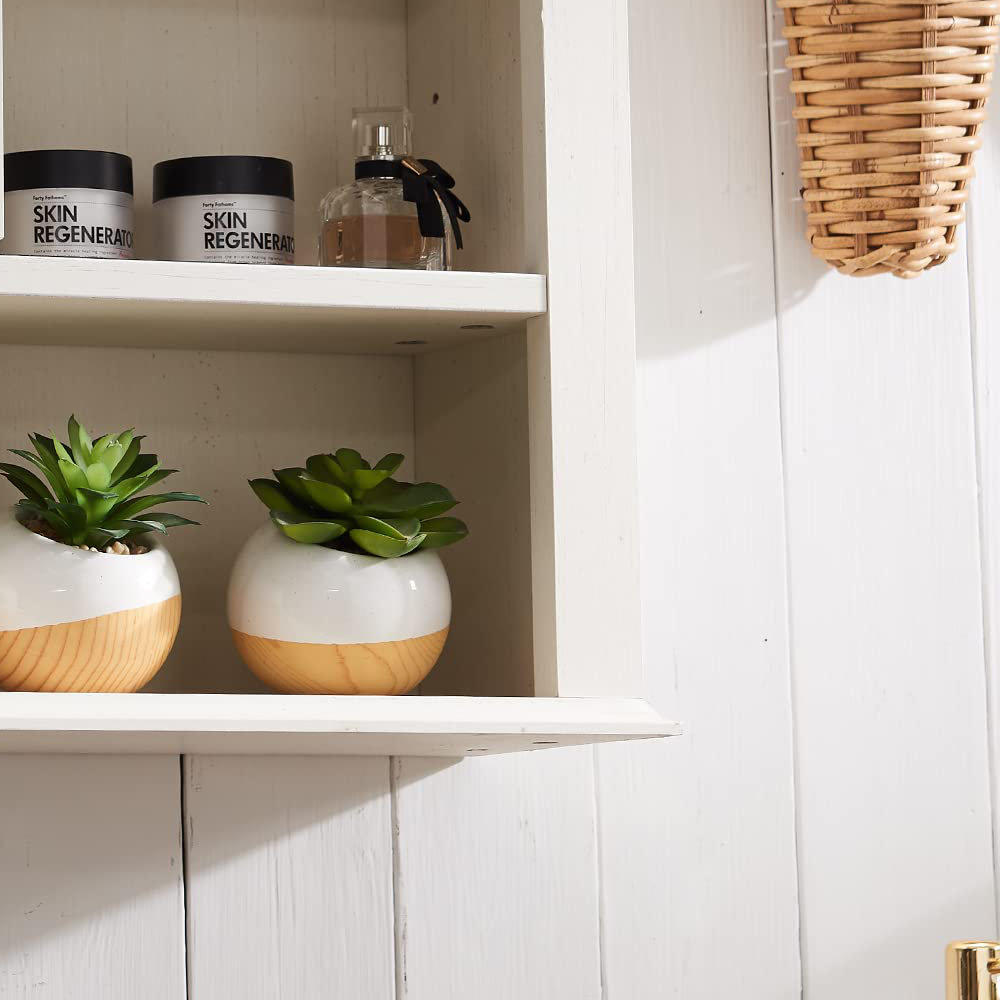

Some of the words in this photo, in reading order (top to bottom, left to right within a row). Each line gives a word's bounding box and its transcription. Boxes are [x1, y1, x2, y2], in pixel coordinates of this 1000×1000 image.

[33, 205, 77, 223] SKIN
[203, 212, 247, 230] SKIN
[34, 225, 134, 249] REGENERATO
